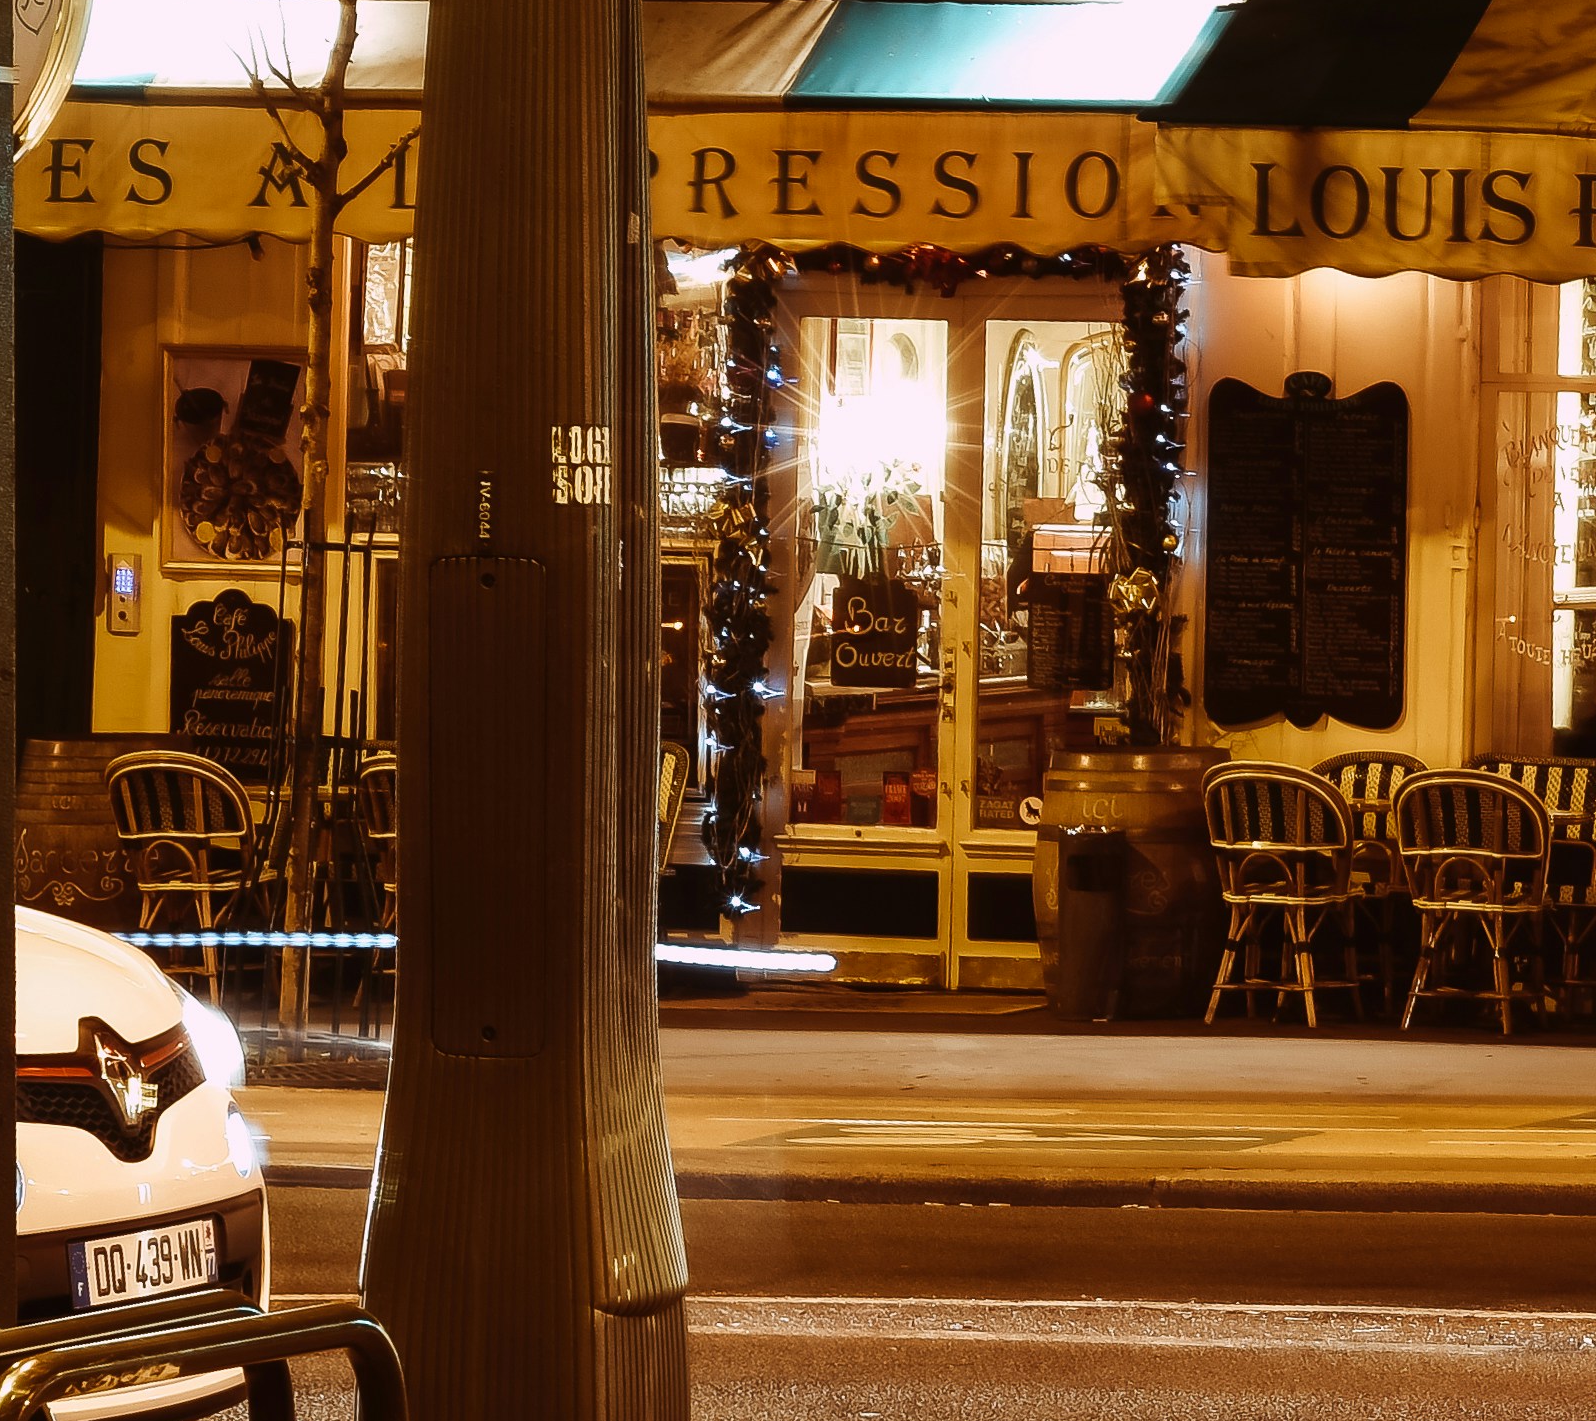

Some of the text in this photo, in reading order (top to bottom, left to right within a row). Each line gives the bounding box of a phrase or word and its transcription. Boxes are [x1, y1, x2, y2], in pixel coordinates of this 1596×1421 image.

[649, 147, 1200, 219] RESSIO
[1250, 162, 1537, 246] LOUIS
[213, 602, 248, 631] Café
[844, 596, 907, 635] Bar
[835, 641, 916, 669] Ouvert
[979, 799, 1015, 810] ZAGAT
[979, 810, 1015, 819] RATED
[1081, 795, 1124, 820] ici
